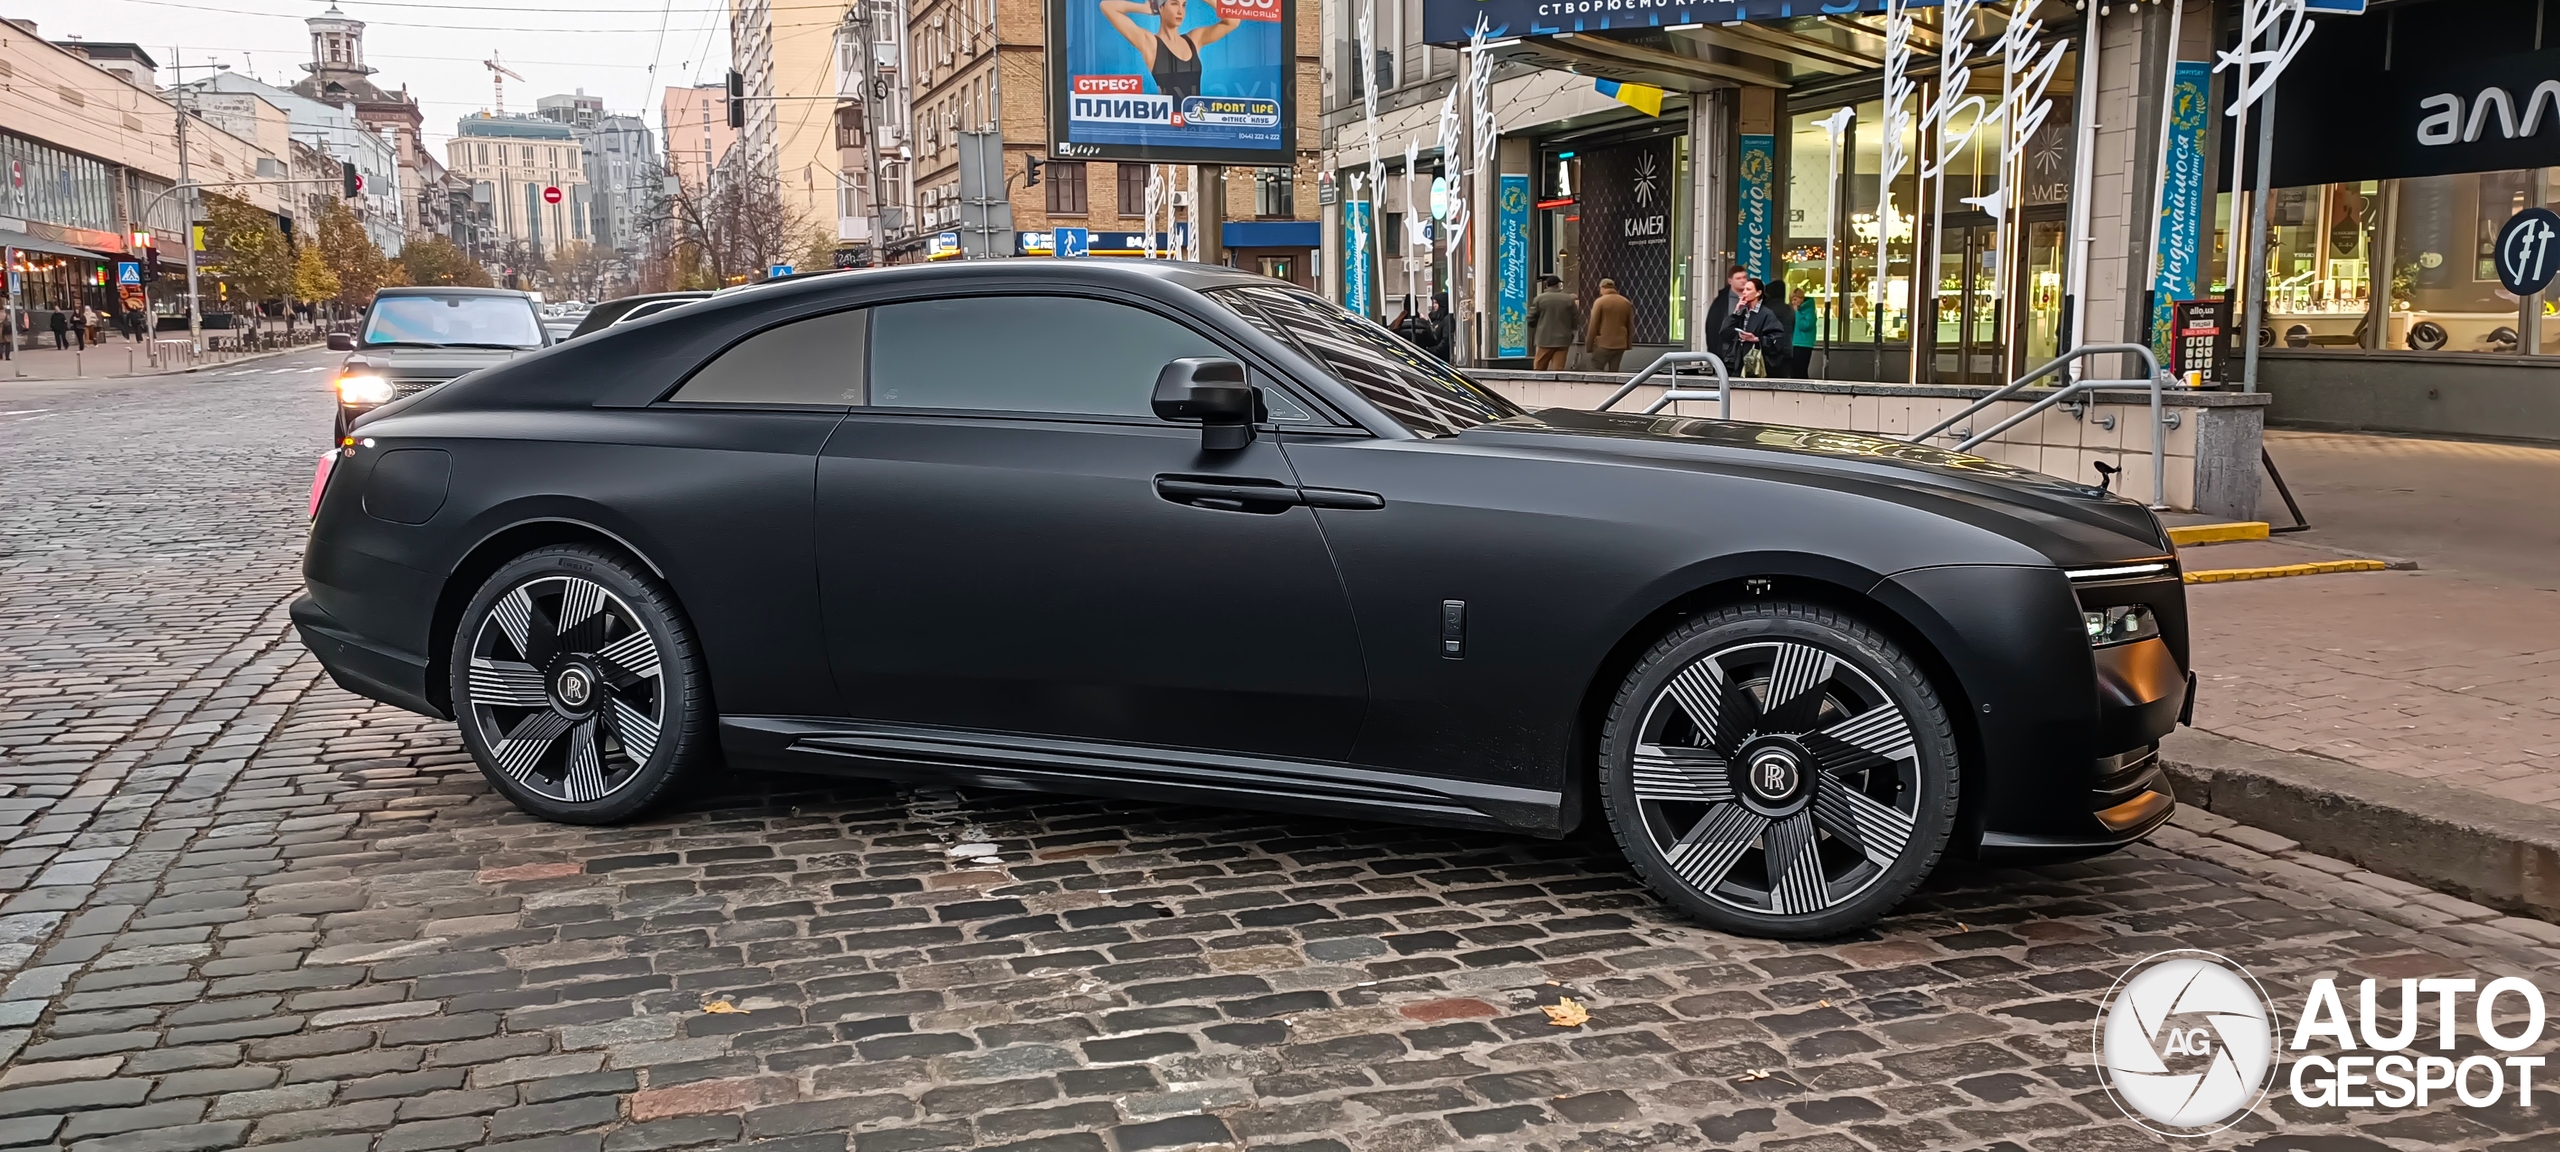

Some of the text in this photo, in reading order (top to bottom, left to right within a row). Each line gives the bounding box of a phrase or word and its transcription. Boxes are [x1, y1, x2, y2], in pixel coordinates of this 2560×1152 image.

[1079, 79, 1138, 91] СТРЕС?
[1075, 98, 1169, 120] ПЛИВИ
[1211, 102, 1274, 114] SPORT LIFE
[1238, 132, 1254, 140] (044)
[1254, 132, 1265, 140] 222
[1270, 133, 1280, 141] 222
[2162, 133, 2190, 293] Надихаймося
[2184, 152, 2202, 254] Бо ми того варті
[1625, 215, 1664, 237] КАМЕЯ
[1503, 218, 1520, 300] Пробуджуйся
